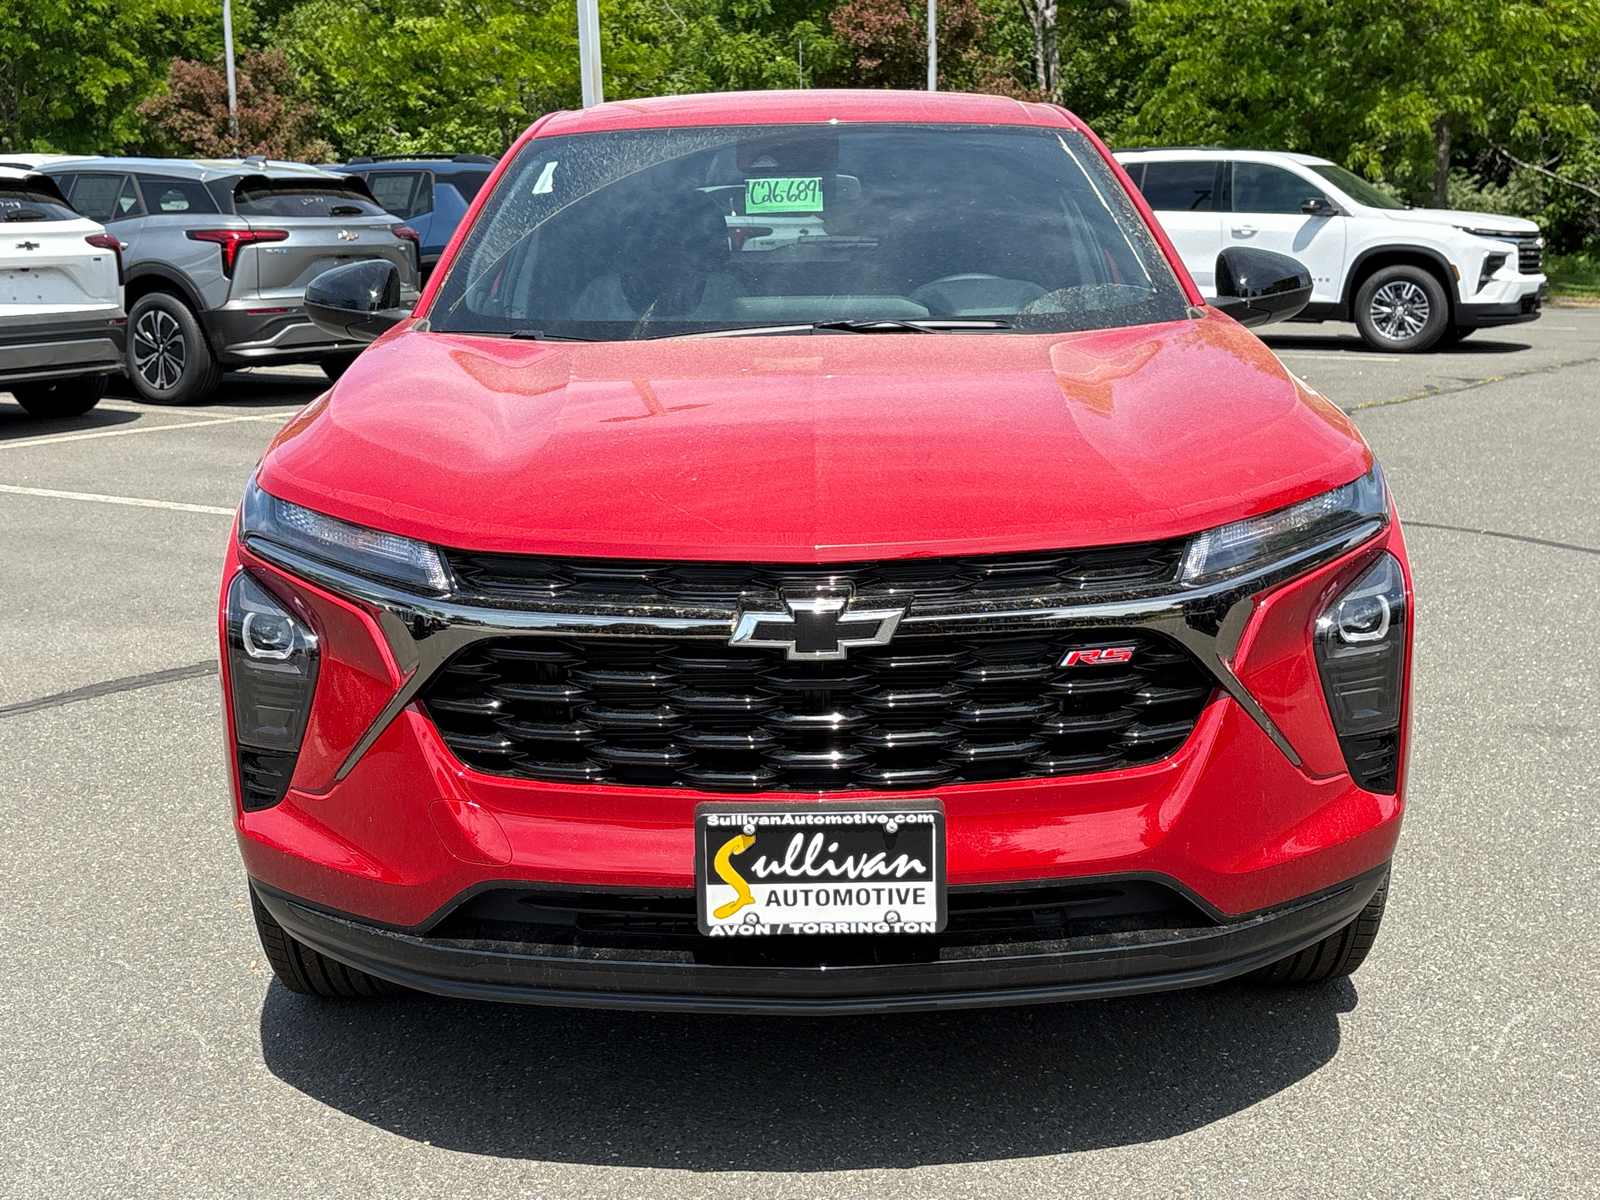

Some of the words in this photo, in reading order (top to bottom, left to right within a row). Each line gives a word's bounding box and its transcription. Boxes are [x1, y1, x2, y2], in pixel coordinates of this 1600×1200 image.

[750, 180, 818, 205] C26-689
[1060, 646, 1137, 666] RS
[706, 812, 935, 827] SullivanAutomotive.com
[713, 832, 928, 919] Sullivan
[765, 887, 927, 907] AUTOMOTIVE
[709, 923, 771, 936] AVON
[789, 921, 937, 935] TORRINGTON
